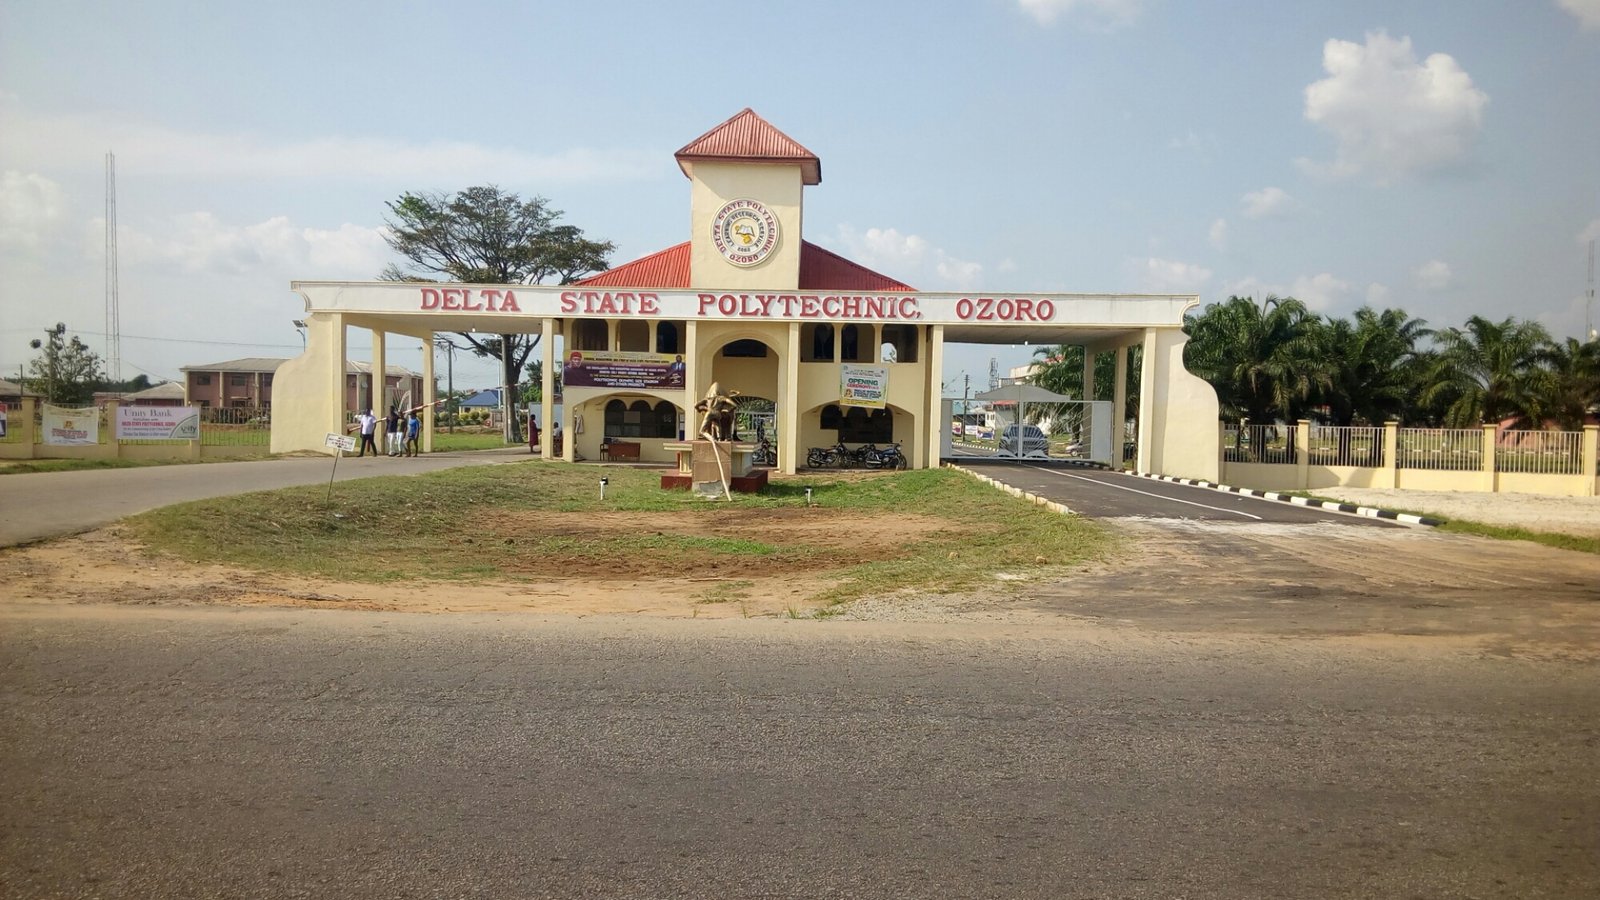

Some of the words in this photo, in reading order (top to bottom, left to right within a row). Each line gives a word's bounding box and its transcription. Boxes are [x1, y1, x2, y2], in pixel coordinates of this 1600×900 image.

[718, 201, 743, 220] STATE
[747, 201, 775, 253] POLYTECHNIC
[714, 224, 726, 253] DELTA
[729, 253, 759, 263] OZORO
[420, 288, 521, 312] DELTA
[560, 291, 660, 315] STATE
[697, 293, 921, 319] POLYTECHNIC,
[956, 298, 1055, 321] OZORO
[848, 378, 878, 386] OPENING
[124, 409, 146, 417] Unity
[150, 409, 172, 417] Bank
